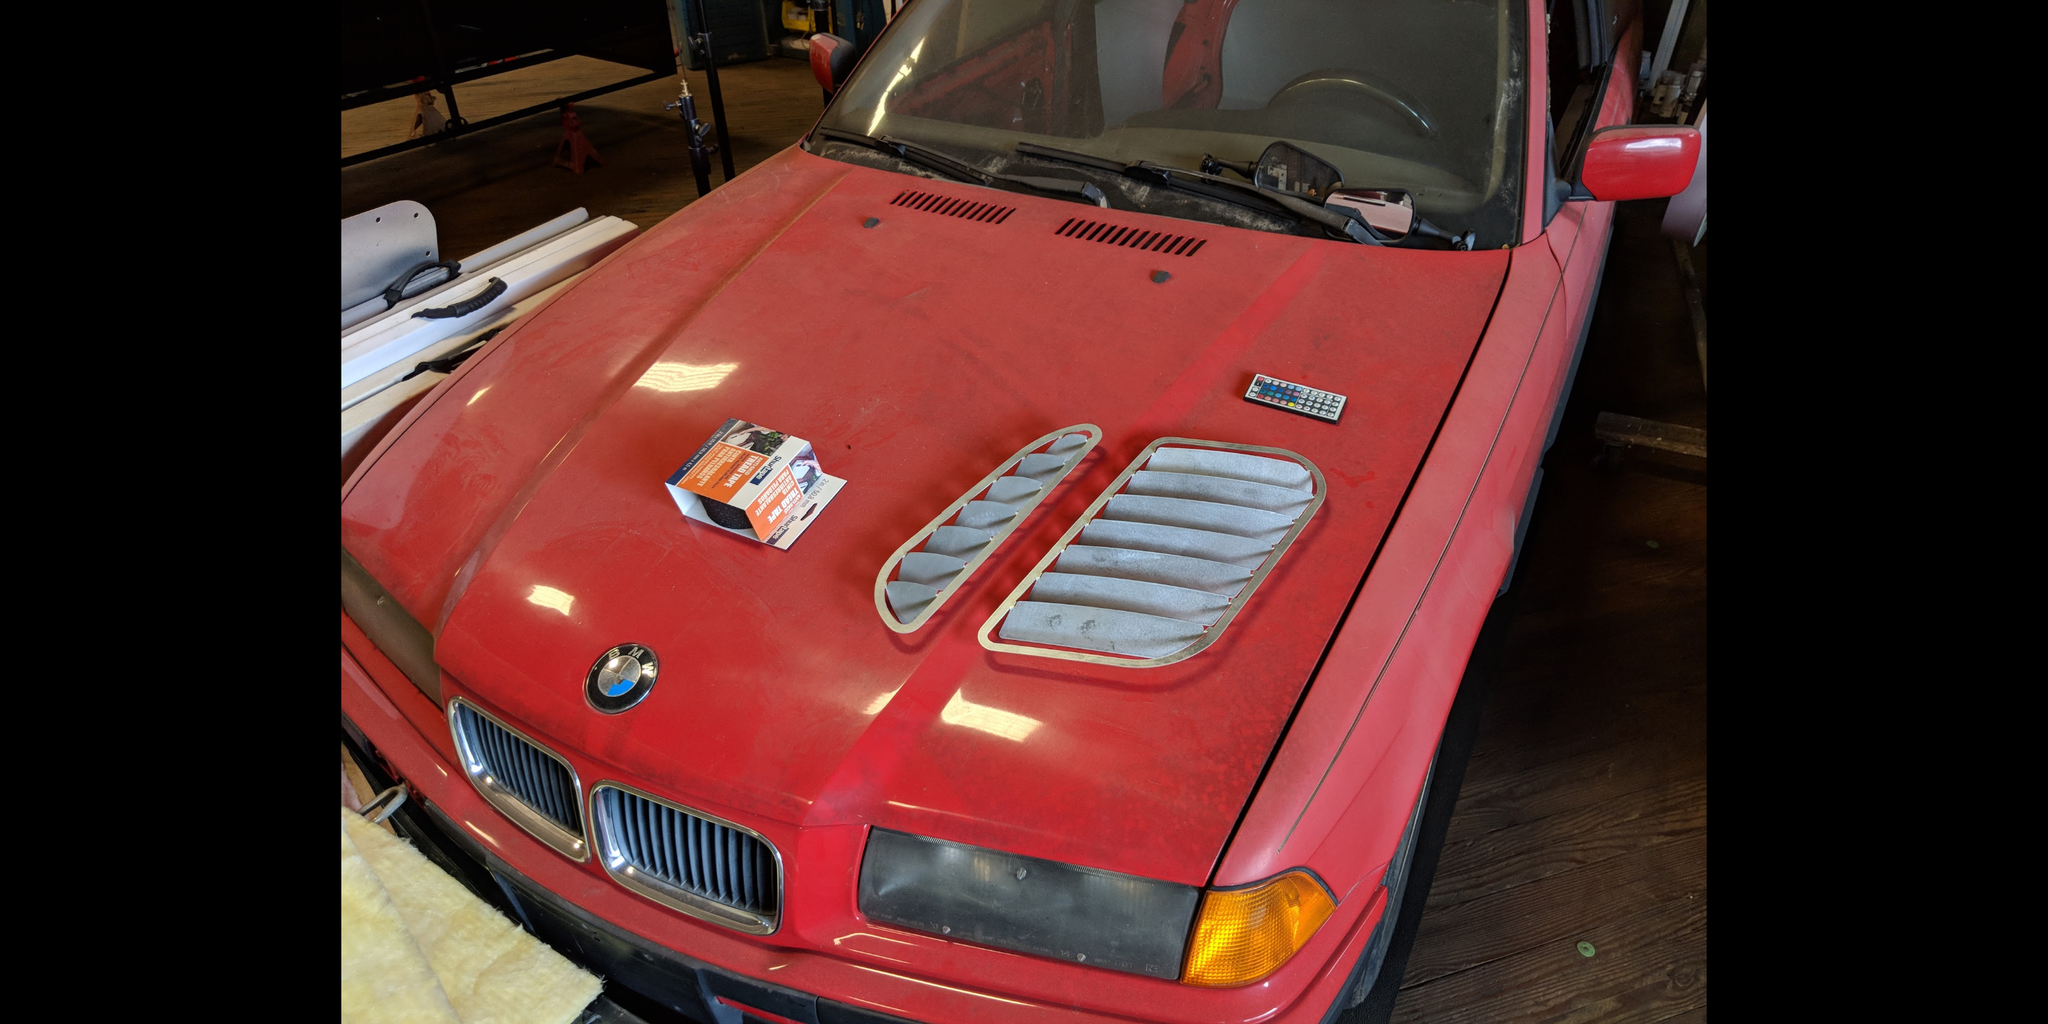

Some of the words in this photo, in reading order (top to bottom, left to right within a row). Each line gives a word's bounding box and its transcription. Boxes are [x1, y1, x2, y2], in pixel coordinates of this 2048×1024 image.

[735, 453, 759, 474] TREAD
[752, 454, 783, 480] Shurtape
[722, 471, 743, 488] TAPE
[780, 485, 799, 509] TREAD
[766, 503, 783, 525] TAPE
[608, 646, 656, 678] BMW
